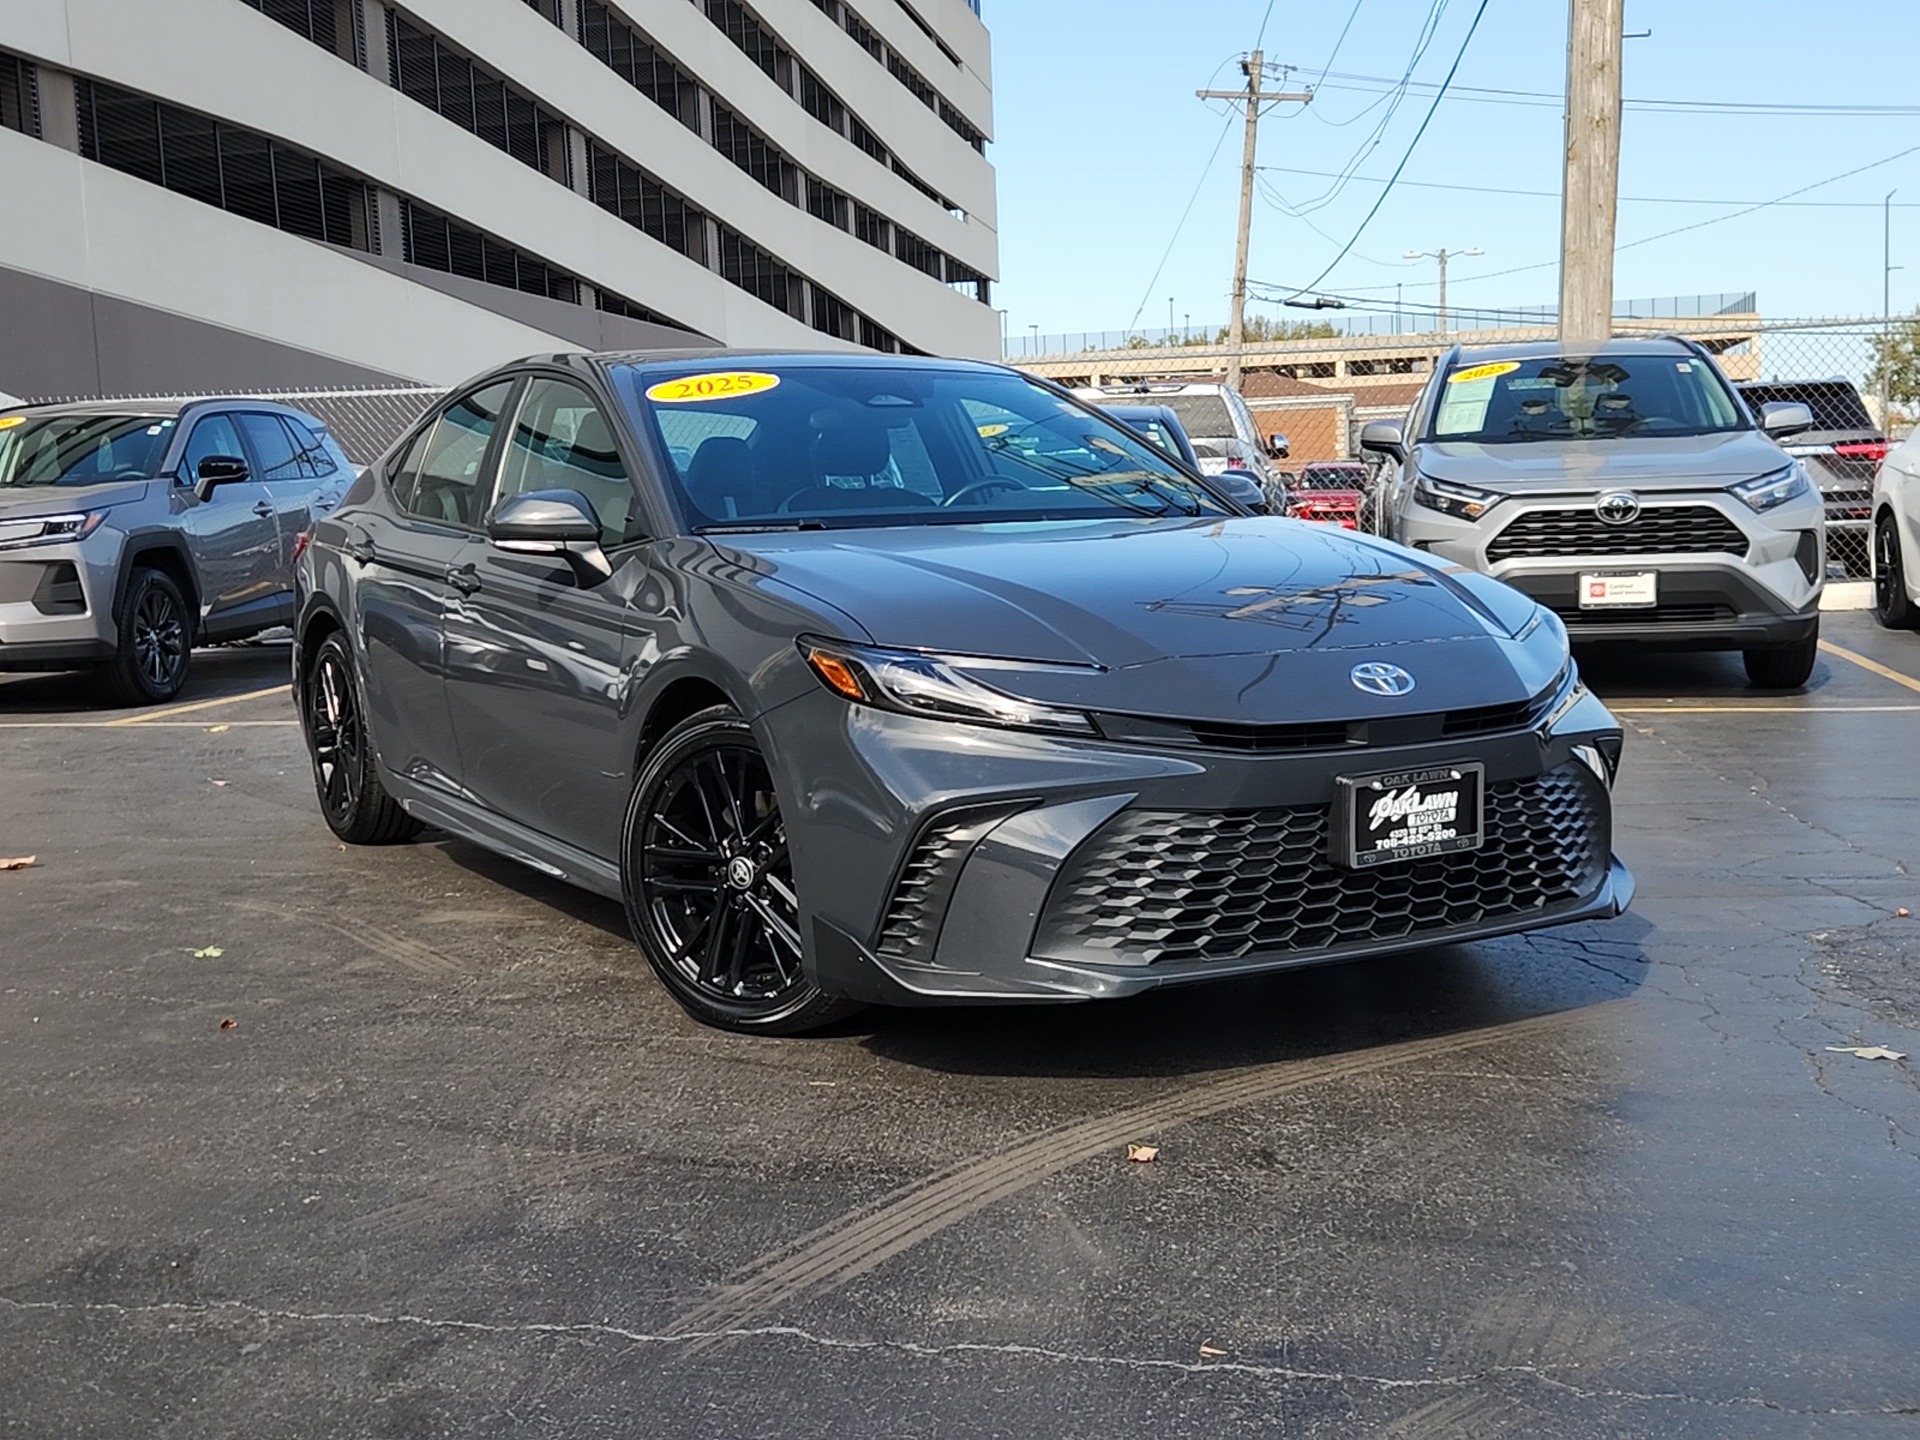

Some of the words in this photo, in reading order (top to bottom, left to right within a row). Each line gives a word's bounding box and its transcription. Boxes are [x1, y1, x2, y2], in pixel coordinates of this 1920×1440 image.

[1462, 366, 1505, 379] 2025
[675, 375, 753, 399] 2025
[1384, 774, 1410, 786] OAK
[1413, 769, 1449, 782] LAWN
[1414, 810, 1451, 825] TOYOTA
[1375, 828, 1457, 850] 708-423-5200
[1392, 843, 1442, 859] TOYOTA
